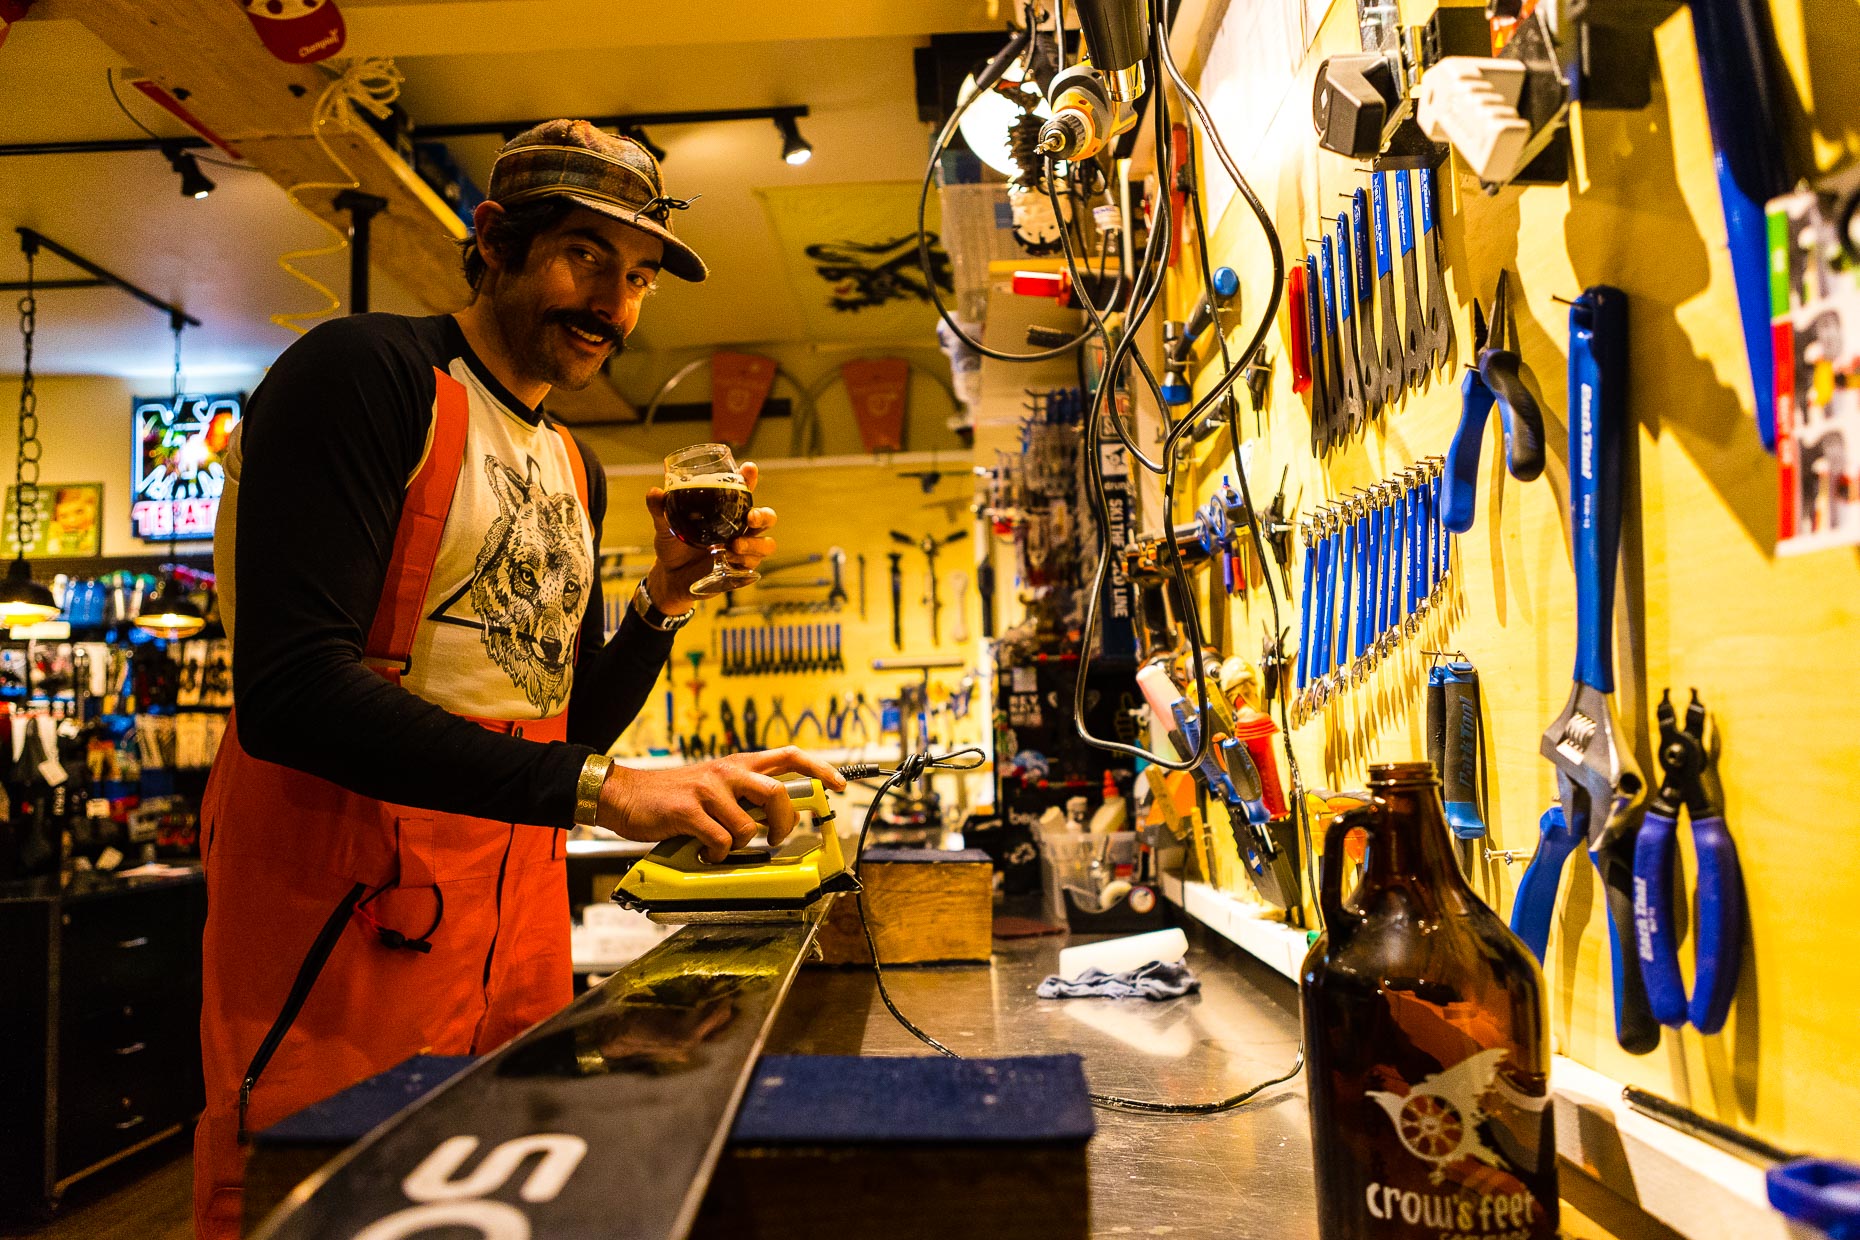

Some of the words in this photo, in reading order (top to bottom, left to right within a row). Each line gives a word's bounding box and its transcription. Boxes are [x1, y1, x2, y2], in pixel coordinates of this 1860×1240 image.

[1108, 498, 1124, 520] SKI
[1113, 587, 1129, 618] LINE
[1459, 695, 1473, 738] Tool
[1459, 737, 1473, 788] Park
[1365, 1181, 1475, 1232] crow's
[1479, 1187, 1538, 1232] feet
